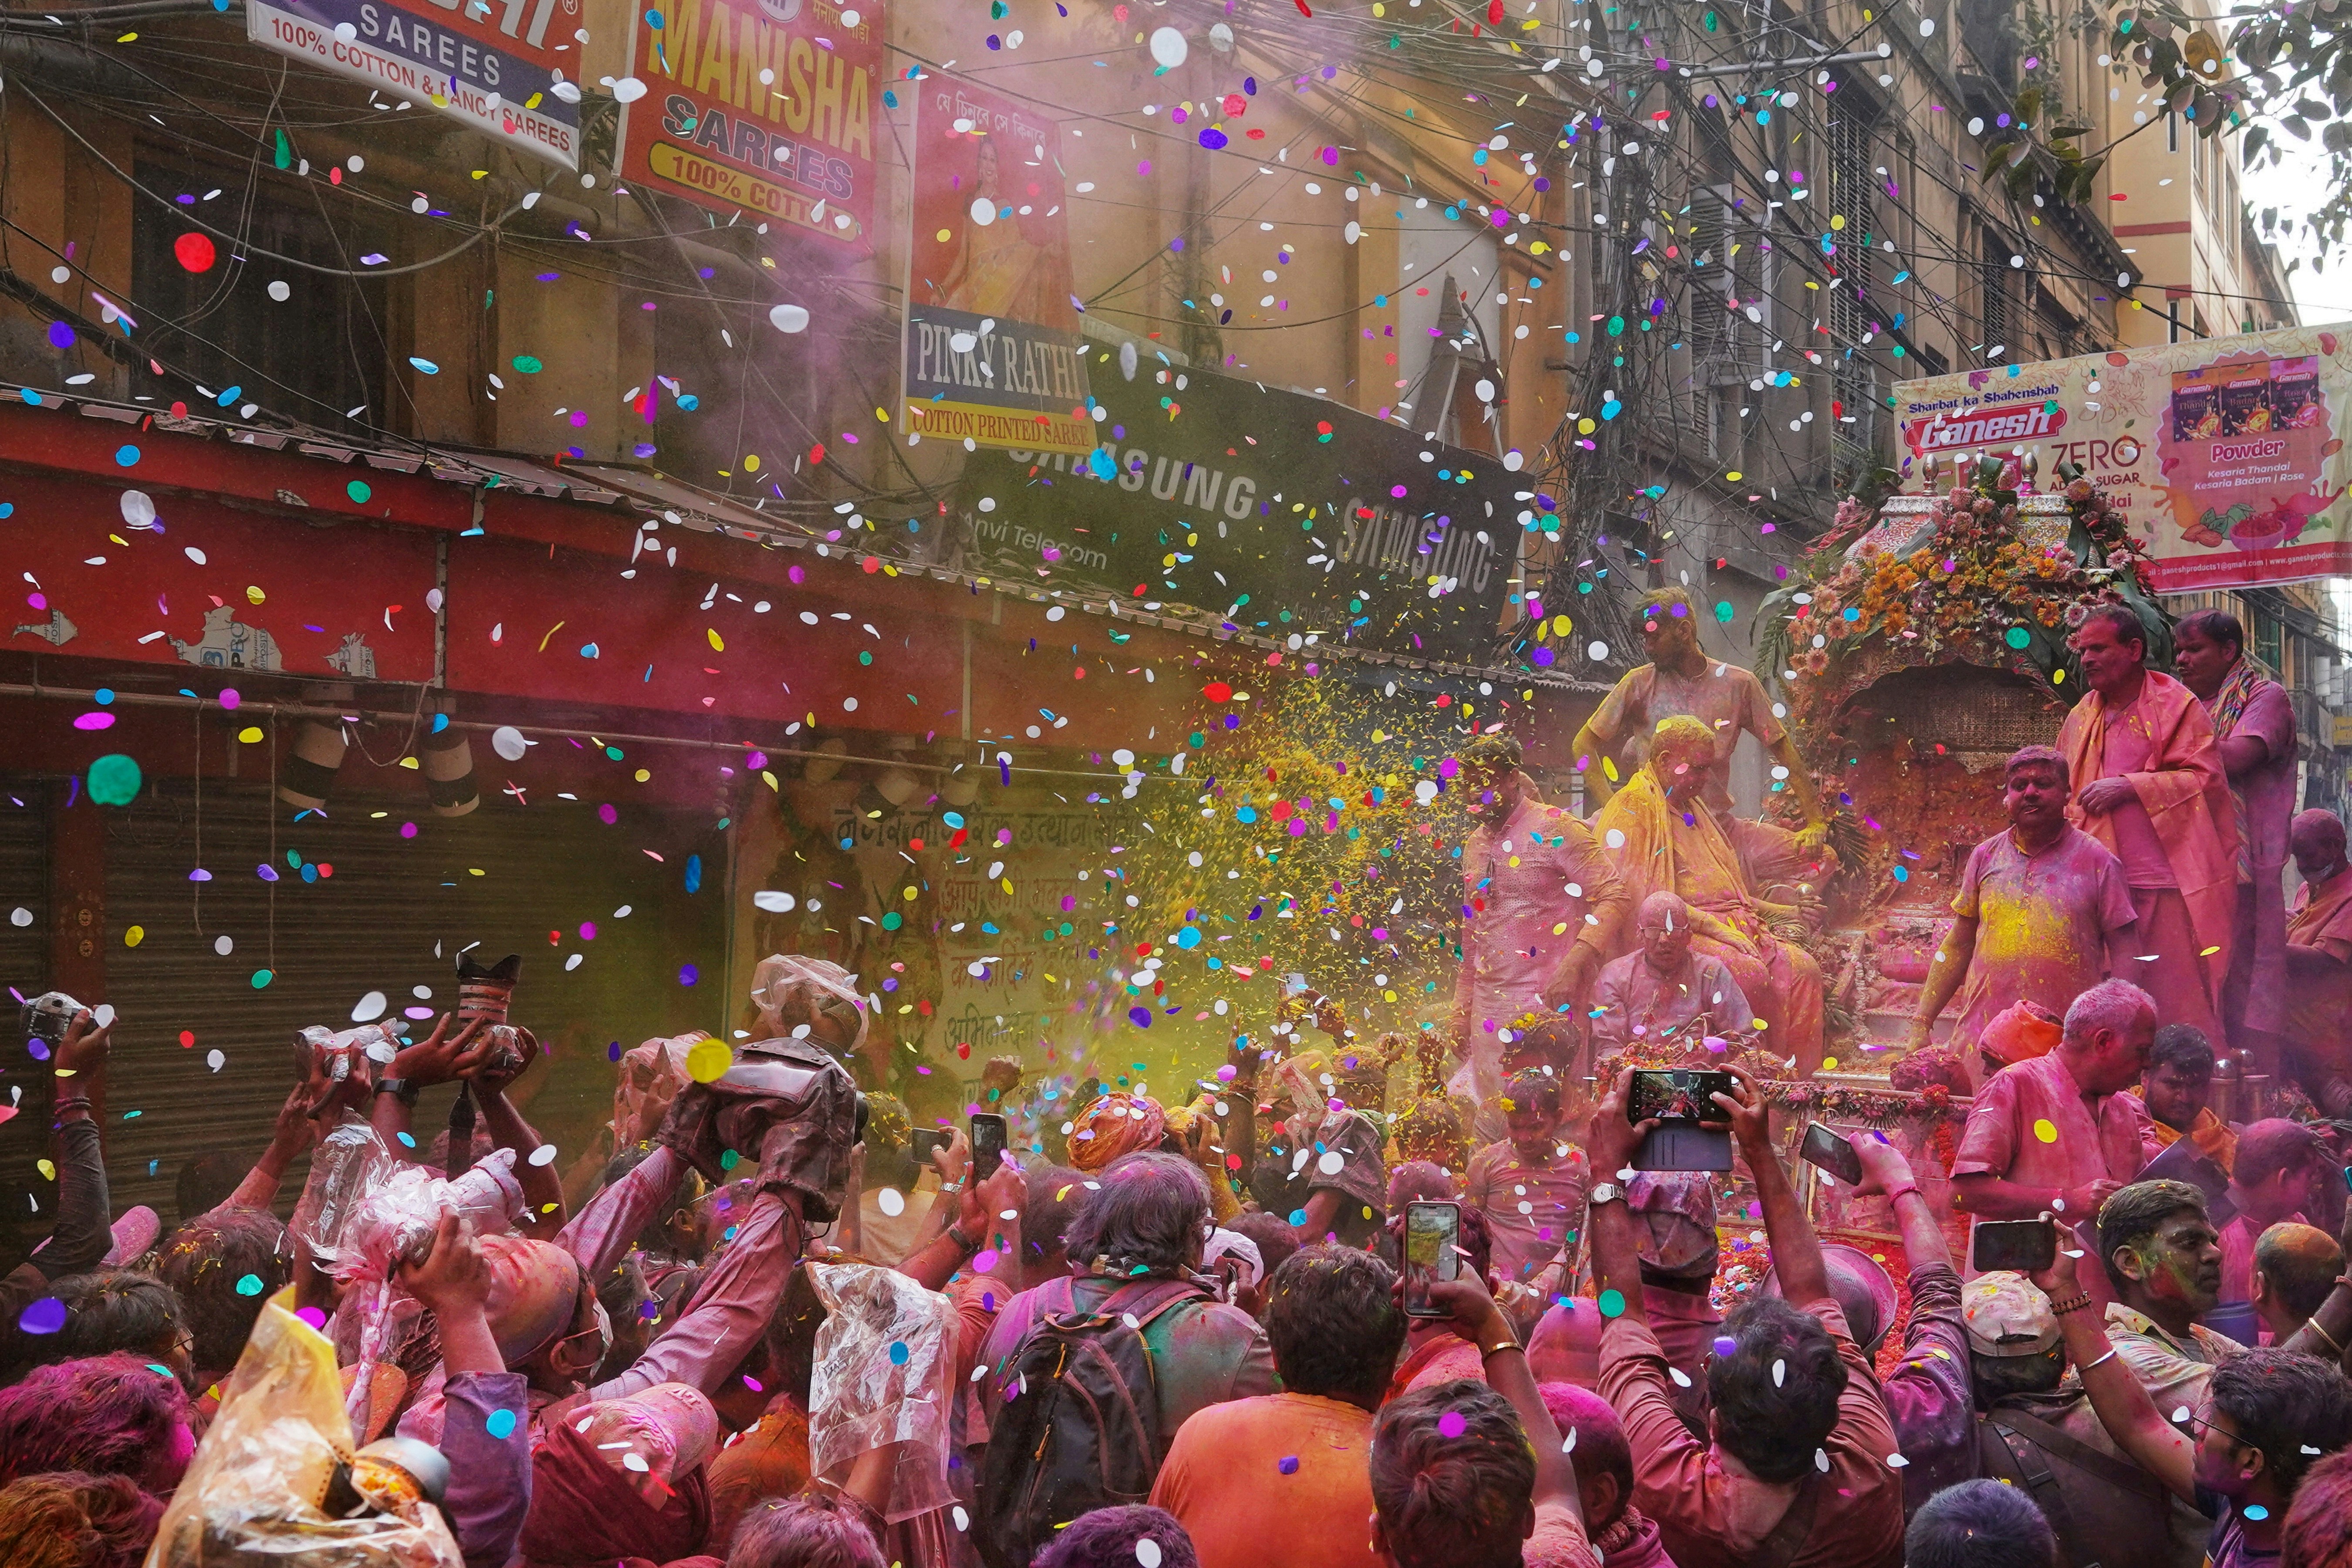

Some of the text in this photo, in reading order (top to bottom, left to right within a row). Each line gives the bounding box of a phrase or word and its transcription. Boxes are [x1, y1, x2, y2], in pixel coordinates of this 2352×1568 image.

[360, 3, 500, 85] SAREES
[272, 17, 326, 56] 100%
[333, 41, 415, 89] COTTON
[421, 75, 433, 95] &
[503, 108, 571, 152] SAREES
[648, 0, 872, 162] MANISHA
[662, 94, 853, 200] SAREES
[672, 155, 741, 199] 100%
[918, 323, 1082, 400] PINKY RATHI
[2279, 372, 2311, 382] Ganesh
[1963, 394, 1979, 407] ka
[1984, 384, 2059, 403] Shahenshah
[2180, 384, 2211, 393] Ganesh
[2230, 378, 2261, 388] Ganesh
[913, 409, 973, 436] COTTON
[978, 415, 1041, 442] PRINTED
[1920, 405, 2052, 449] Ganesh
[2051, 438, 2141, 475] ZERO
[2211, 439, 2285, 463] Powder
[2096, 472, 2140, 486] SUGAR
[2194, 472, 2305, 490] Kesaria Badam Rose
[2208, 462, 2291, 478] Kesaria Thandai
[1336, 497, 1495, 593] SAMSUNG
